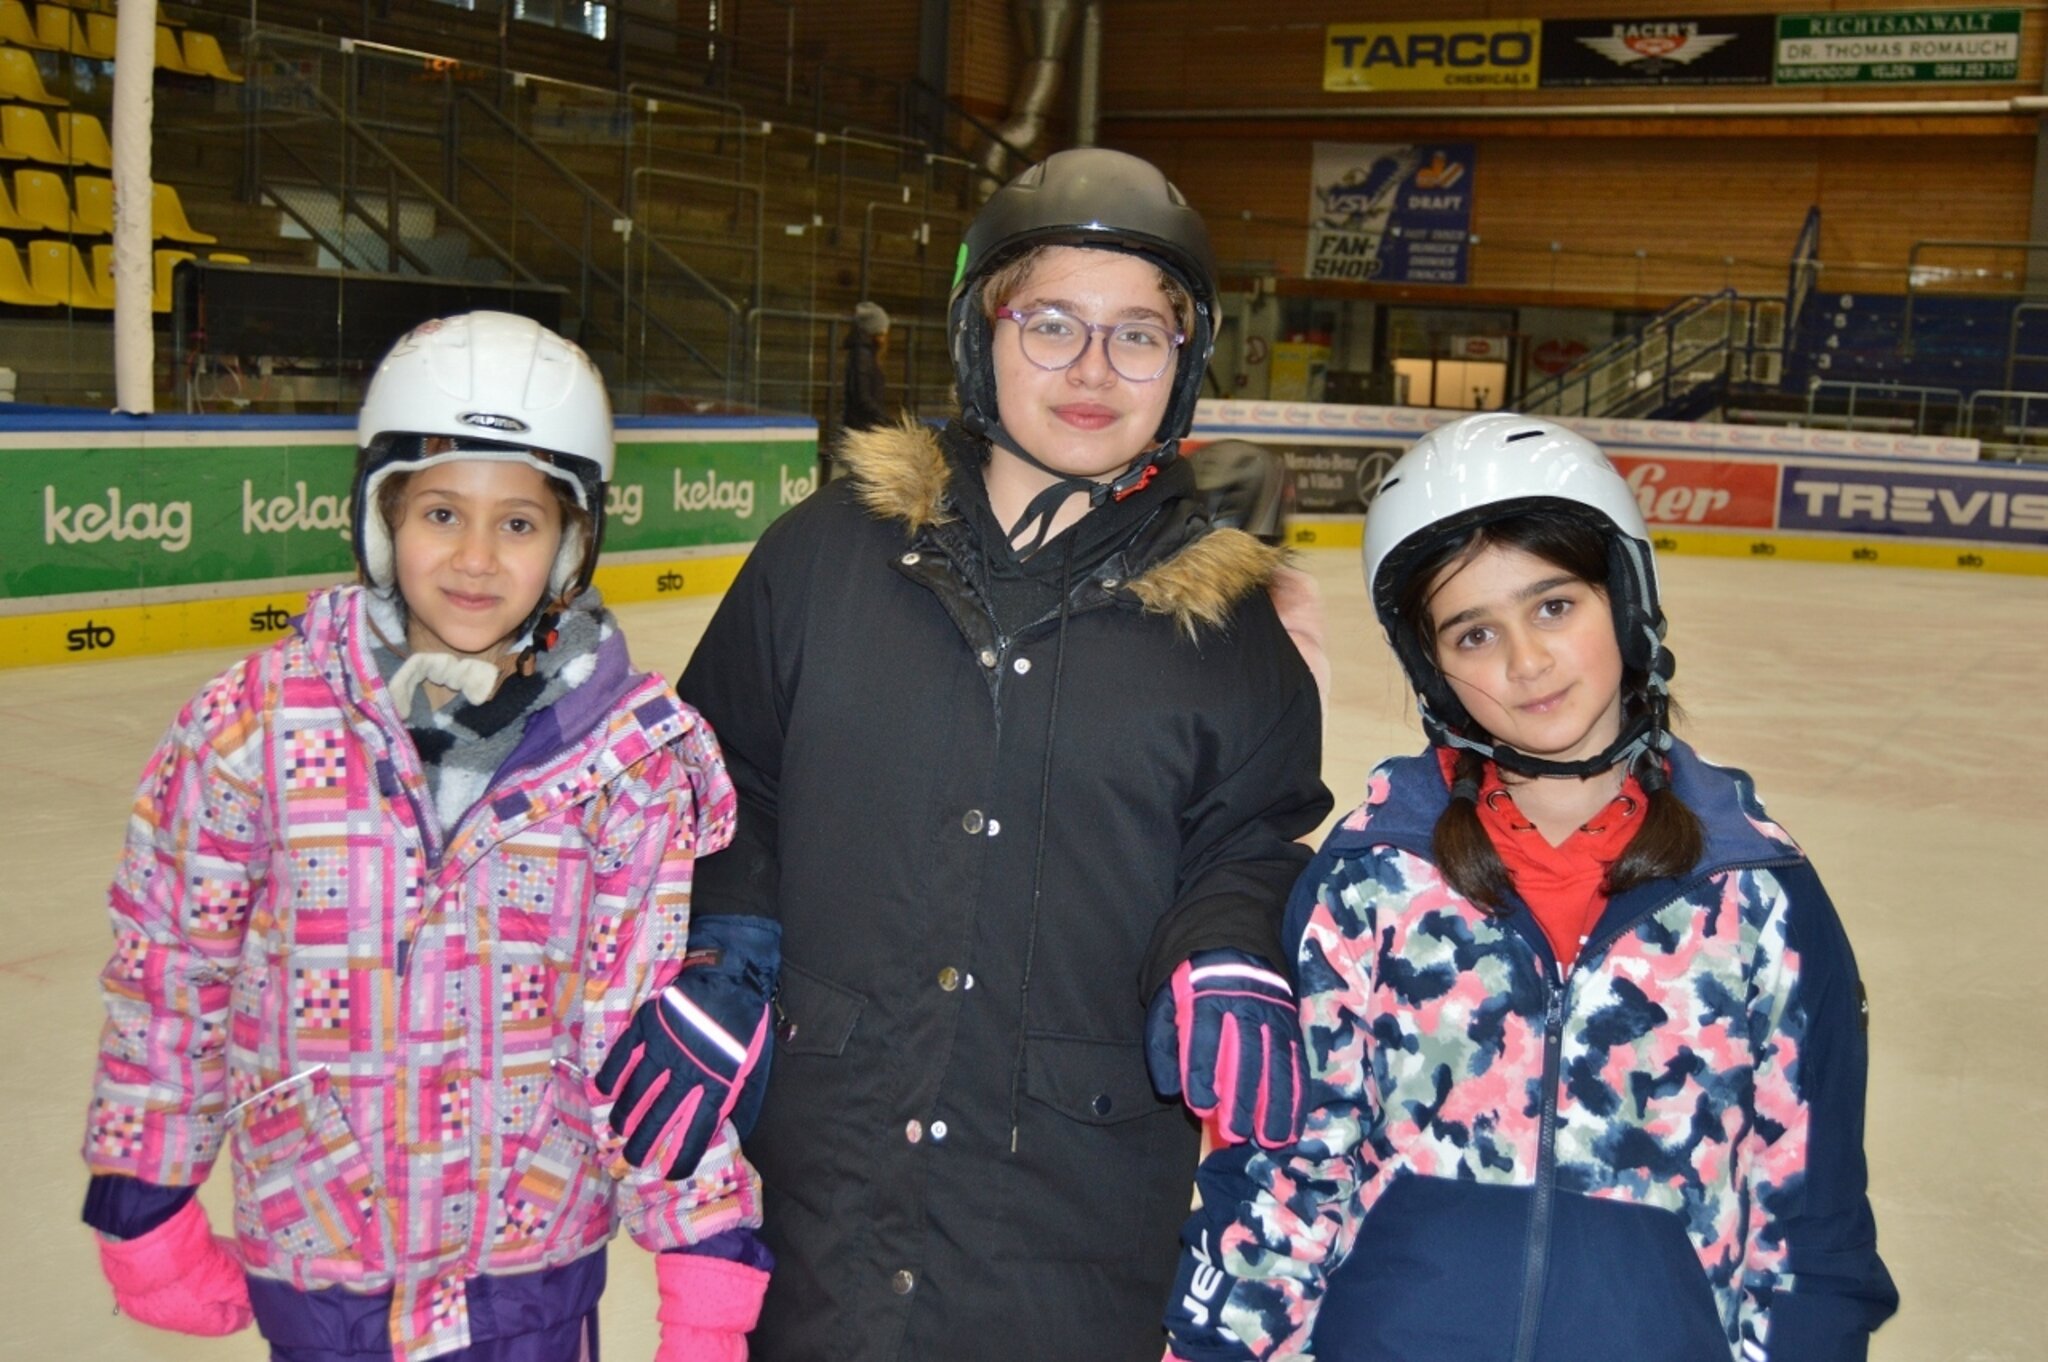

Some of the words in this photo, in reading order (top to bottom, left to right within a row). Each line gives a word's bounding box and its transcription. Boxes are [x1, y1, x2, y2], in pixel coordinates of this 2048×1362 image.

[1613, 22, 1699, 38] RACER'S
[1809, 14, 1992, 36] RECHTSANWALT
[1330, 31, 1533, 68] TARCO
[1787, 44, 1818, 60] DR.
[1825, 41, 1901, 59] THOMAS
[1910, 39, 2008, 57] ROMAUCH
[1444, 72, 1531, 85] CHEMICALS
[1407, 196, 1463, 211] DRAFT
[1317, 235, 1376, 257] FAN-
[1311, 258, 1383, 279] SHOP
[465, 415, 523, 431] ALPINA
[673, 467, 755, 519] kelag
[779, 464, 818, 506] kel
[45, 484, 192, 552] kelag
[1750, 540, 1776, 556] sto
[1852, 546, 1879, 562] sto
[1957, 552, 1984, 569] sto
[656, 569, 685, 593] sto
[249, 604, 290, 631] sto
[66, 620, 116, 652] sto
